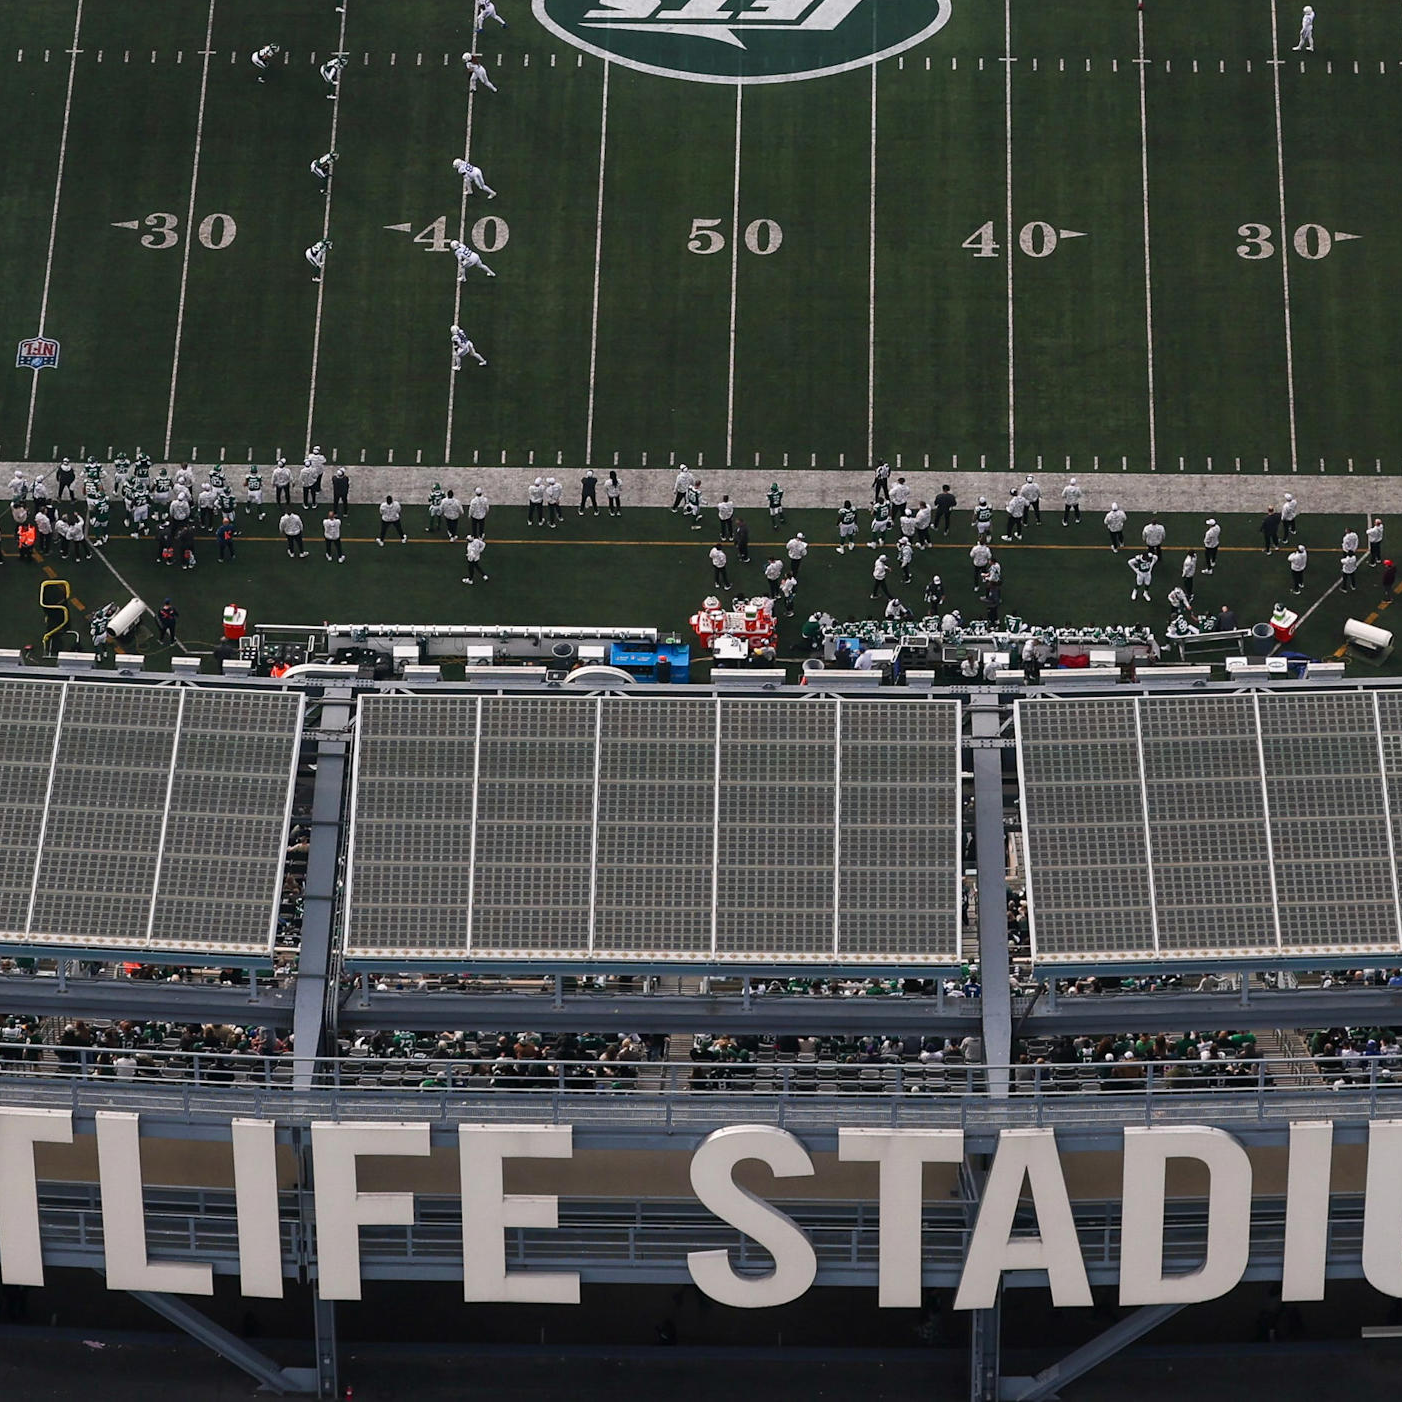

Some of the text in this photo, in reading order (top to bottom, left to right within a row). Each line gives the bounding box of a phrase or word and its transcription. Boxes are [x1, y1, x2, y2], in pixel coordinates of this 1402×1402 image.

[140, 213, 237, 250] 30
[413, 215, 510, 253] 40
[688, 218, 783, 255] 50
[961, 221, 1058, 258] 40
[1236, 223, 1332, 260] 30
